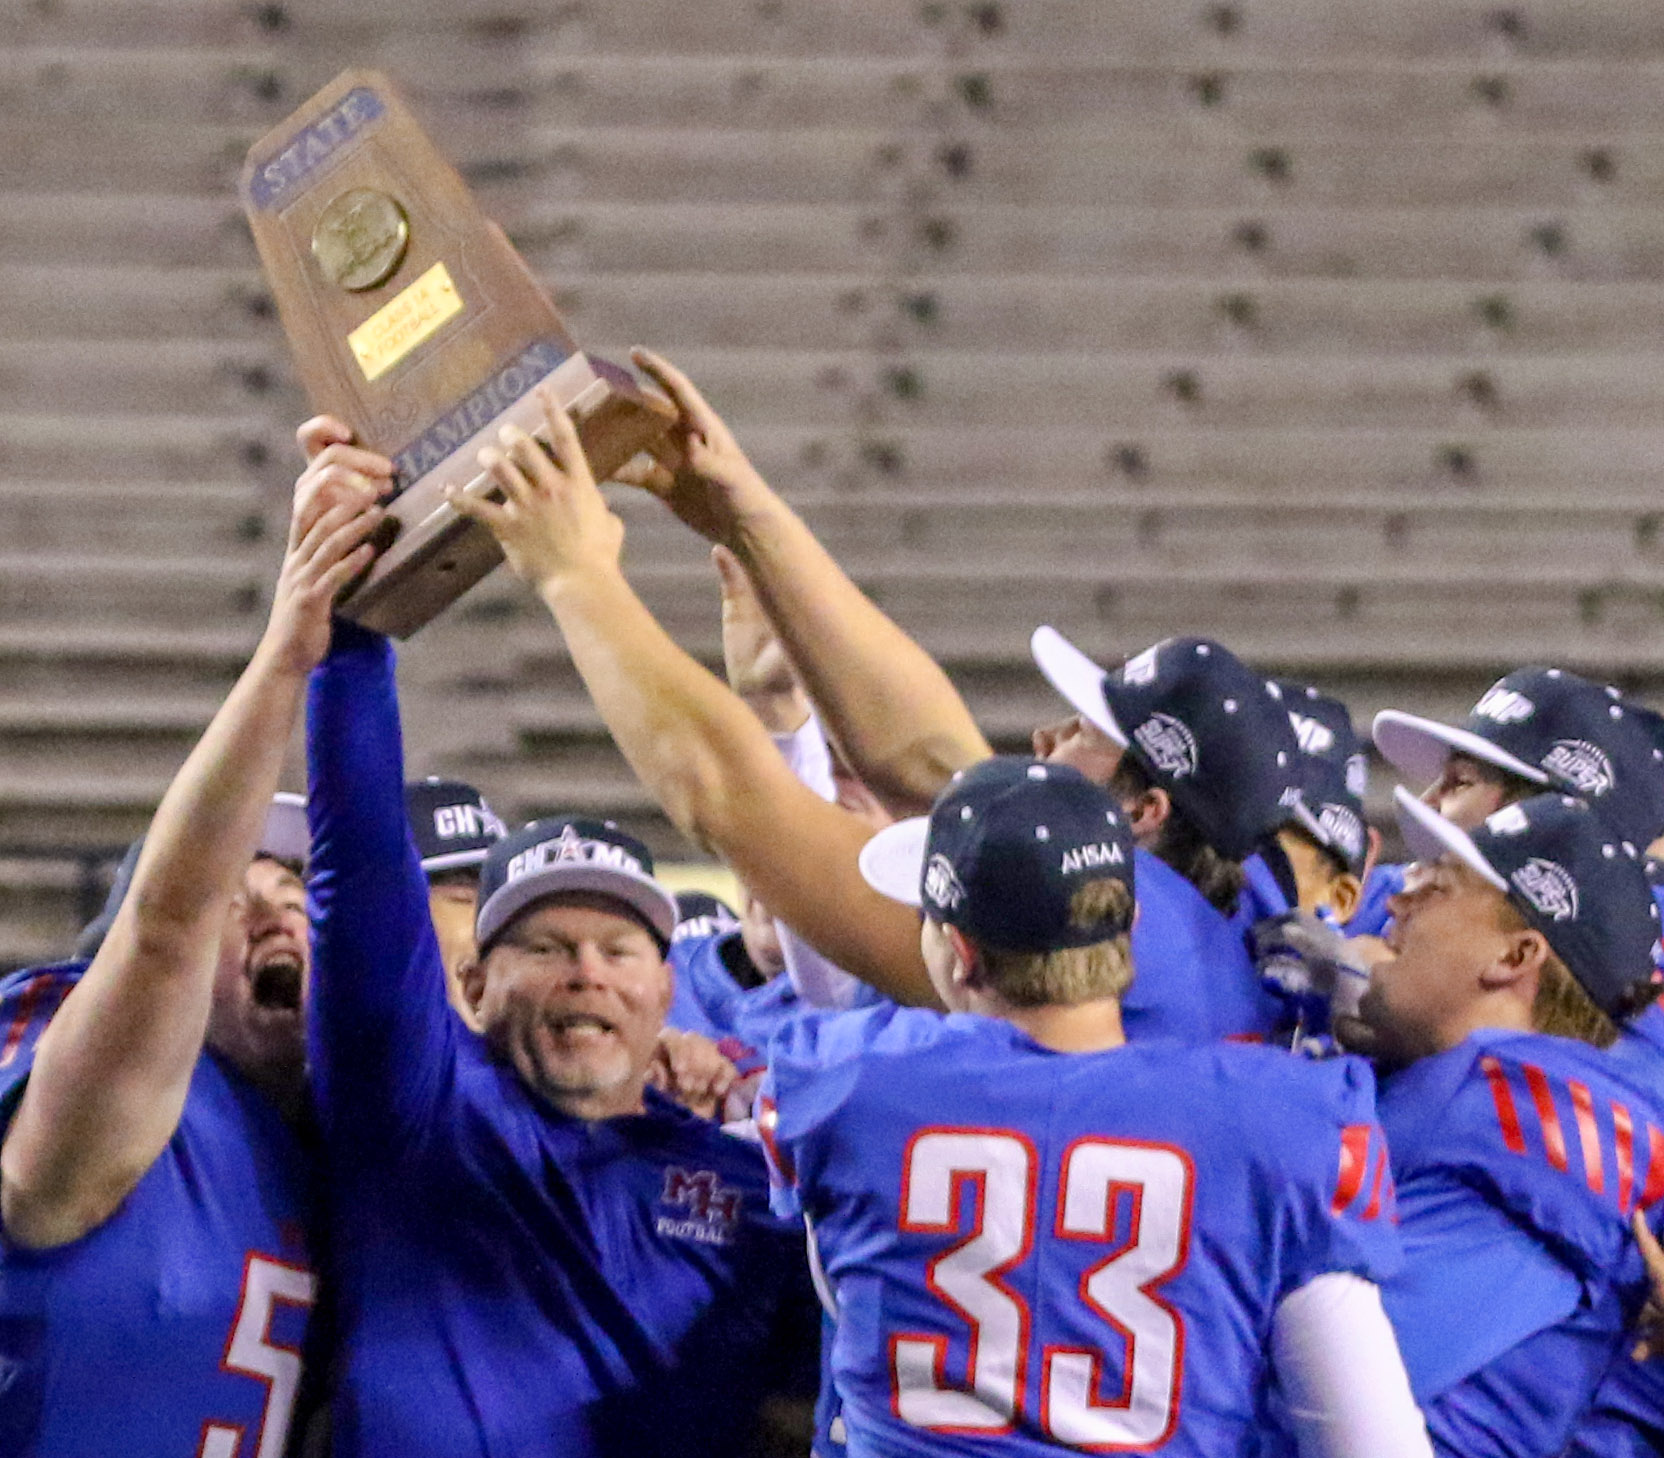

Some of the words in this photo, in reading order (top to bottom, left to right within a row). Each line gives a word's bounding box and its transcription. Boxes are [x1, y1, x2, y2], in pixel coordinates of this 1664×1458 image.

[433, 796, 507, 840] CHA
[1061, 841, 1125, 875] AHSAA
[889, 1125, 1196, 1454] 33
